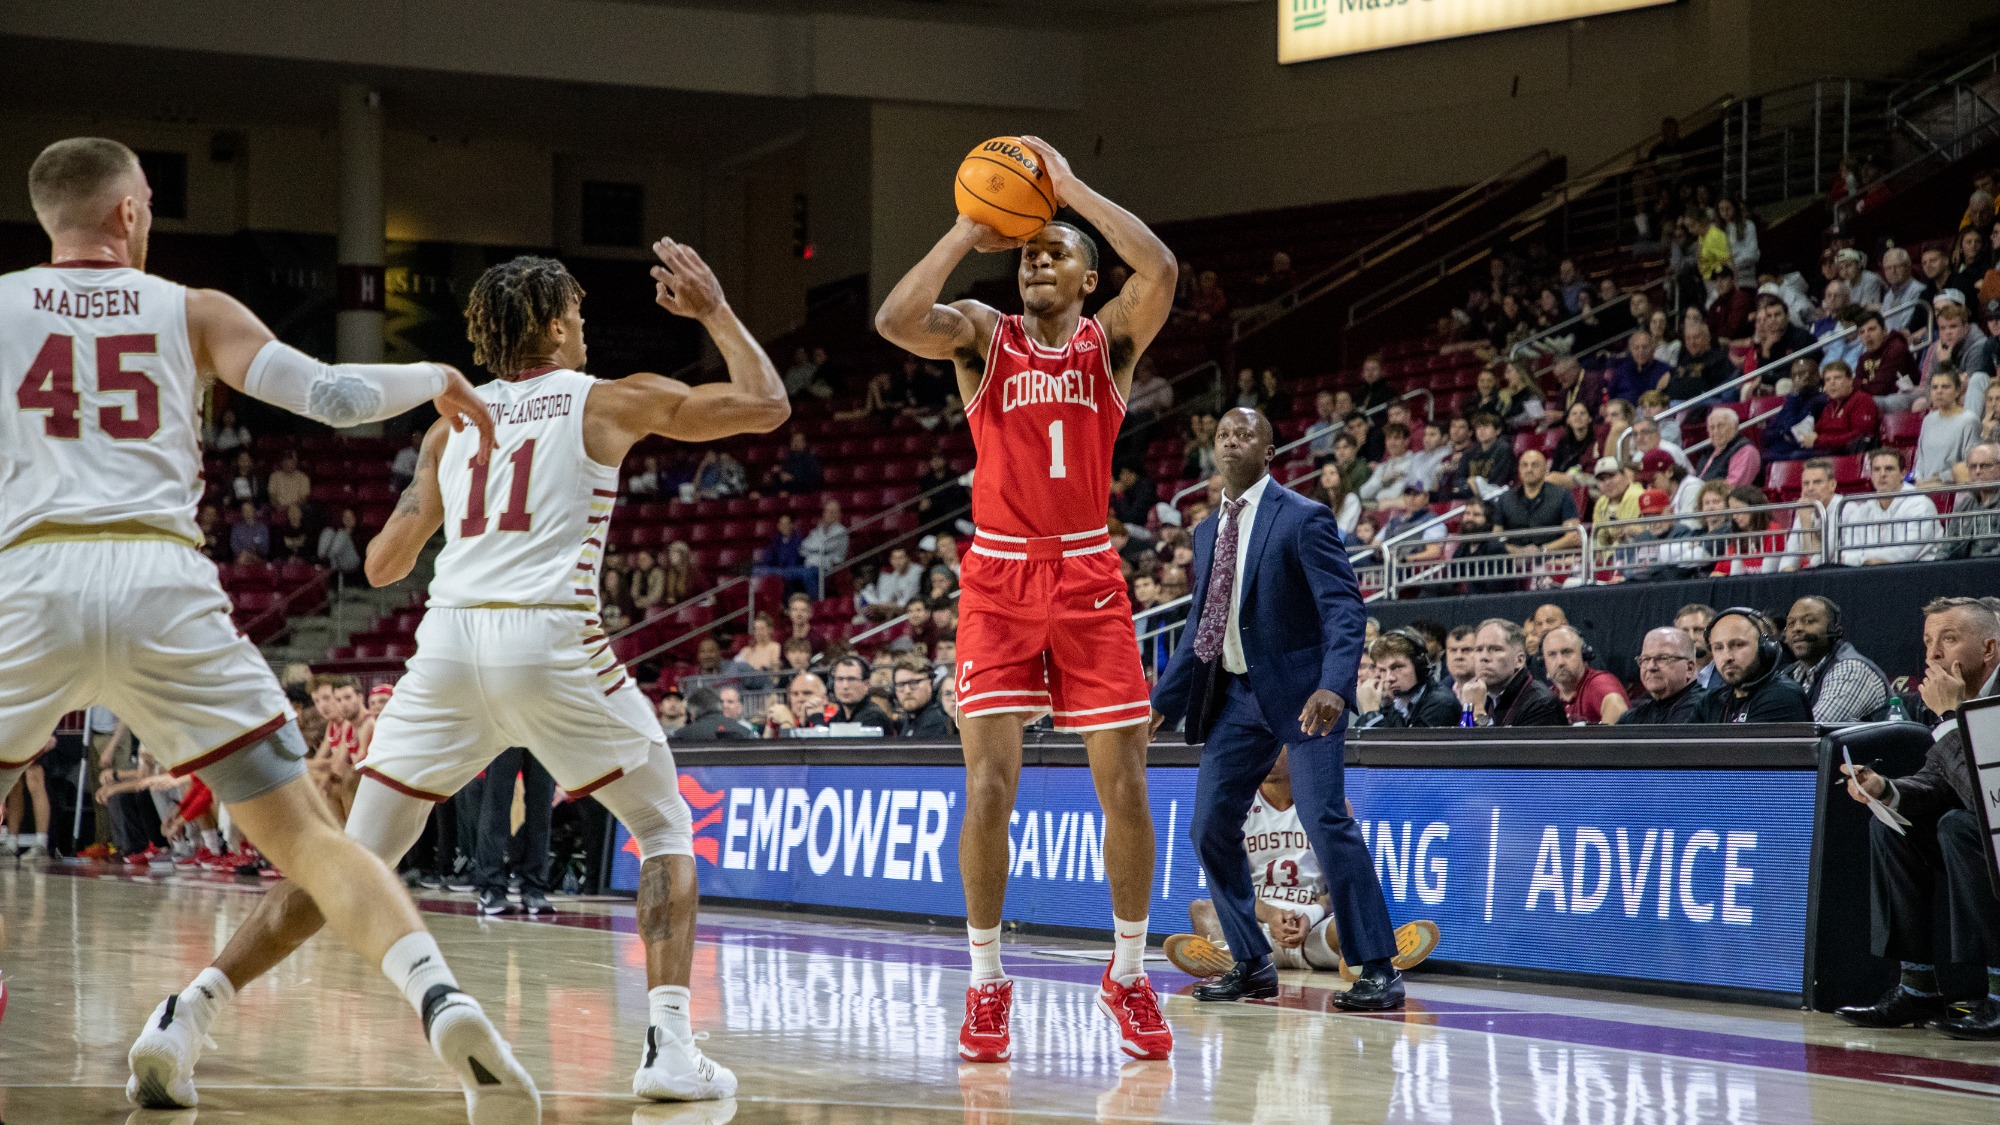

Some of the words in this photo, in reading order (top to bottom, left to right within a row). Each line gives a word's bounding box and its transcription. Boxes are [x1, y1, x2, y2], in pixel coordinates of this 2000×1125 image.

[982, 141, 1044, 181] Wilson
[33, 288, 140, 318] MADSEN
[16, 333, 161, 441] 45
[1003, 370, 1098, 413] CORNELL
[465, 394, 572, 427] ON-LANGFORD
[1049, 420, 1066, 479] 1
[459, 438, 538, 539] 11
[958, 660, 973, 693] C
[1008, 809, 1107, 883] SAVIN
[1525, 824, 1758, 926] ADVICE
[1265, 859, 1299, 888] 13
